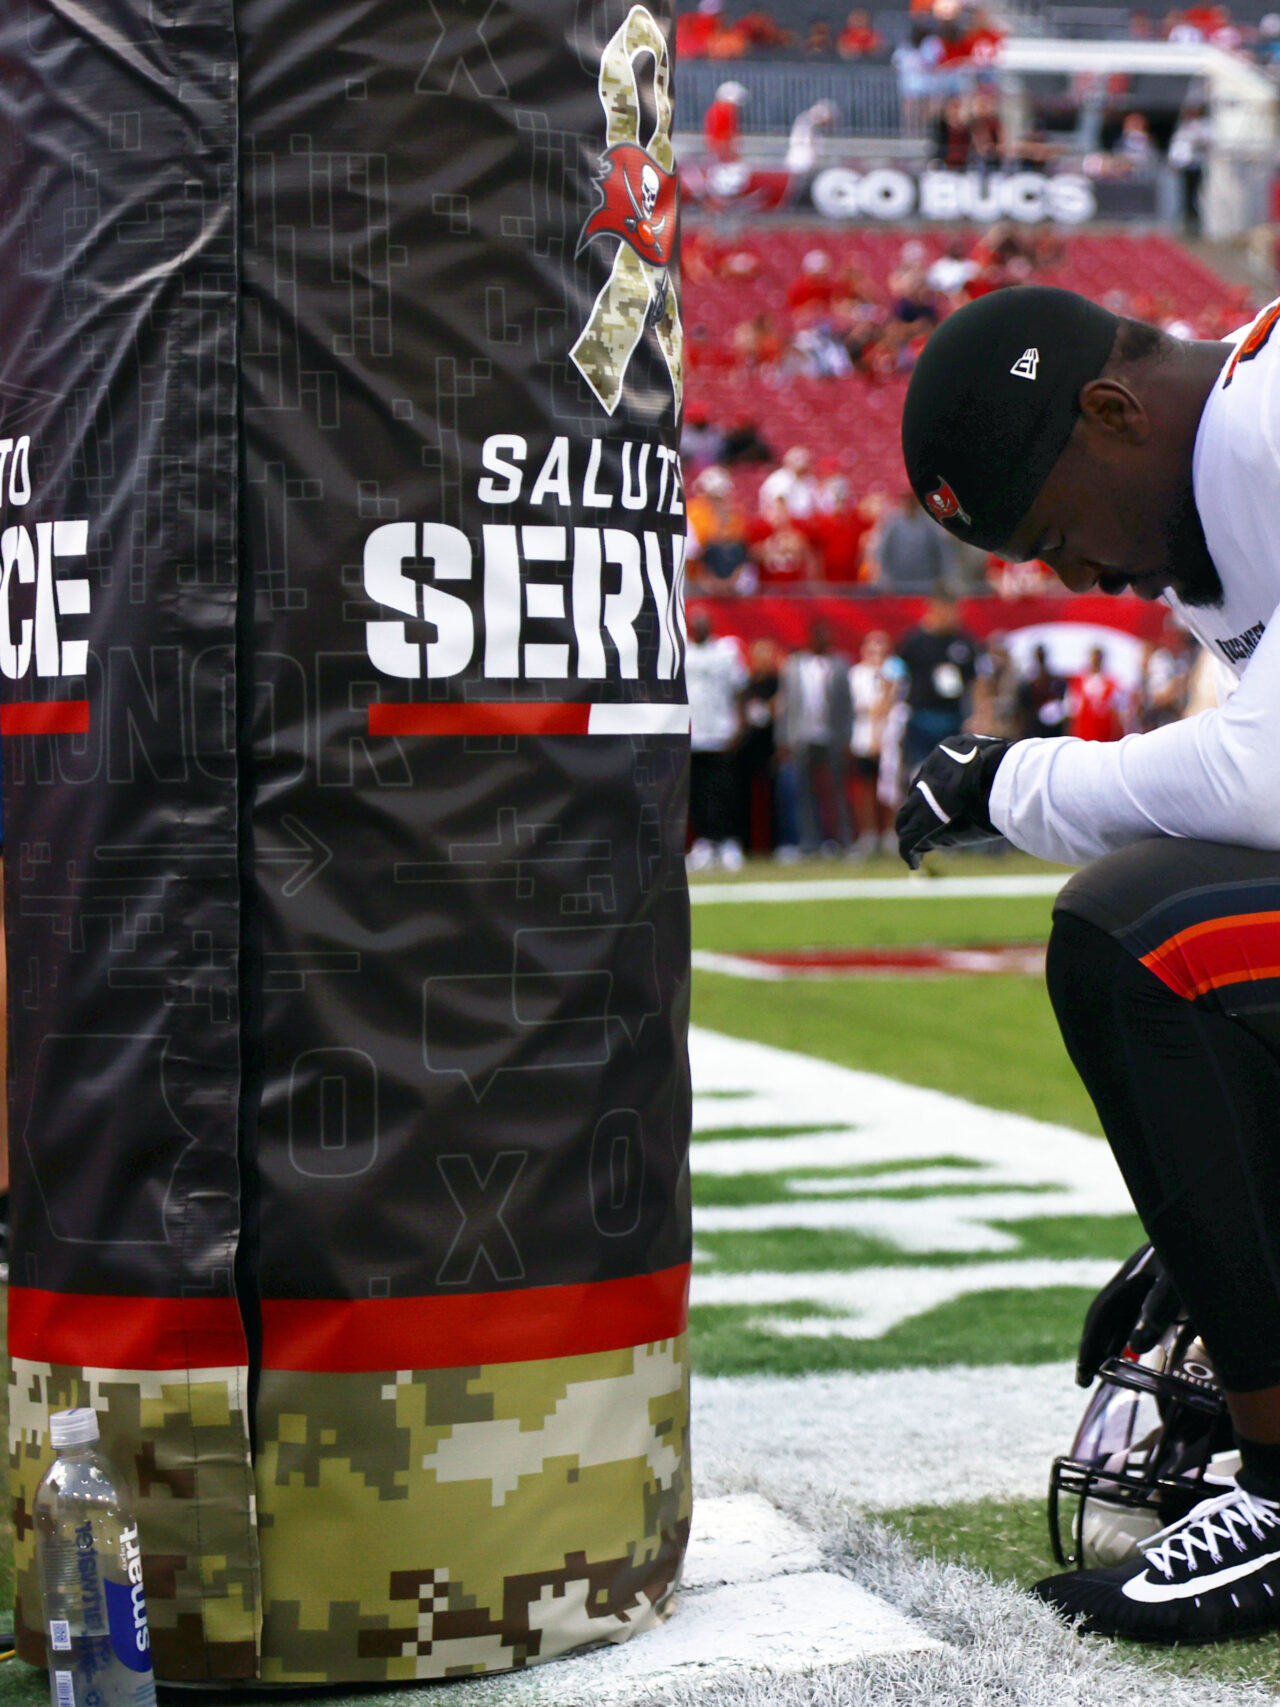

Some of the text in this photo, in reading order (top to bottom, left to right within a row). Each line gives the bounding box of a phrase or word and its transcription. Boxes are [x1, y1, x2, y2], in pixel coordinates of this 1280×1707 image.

[811, 167, 1096, 225] GO BUCS
[119, 1521, 151, 1653] smart
